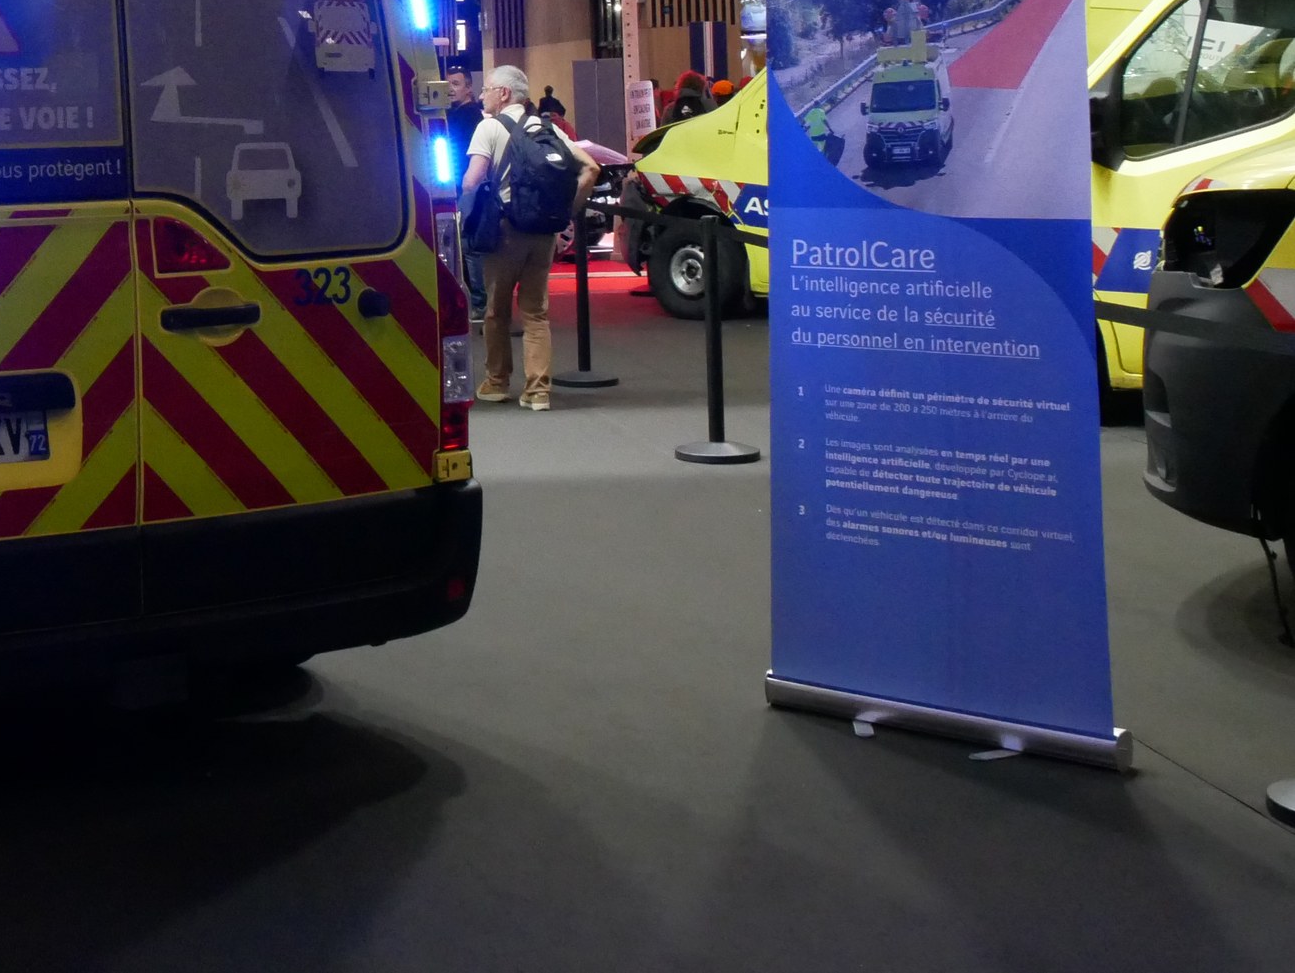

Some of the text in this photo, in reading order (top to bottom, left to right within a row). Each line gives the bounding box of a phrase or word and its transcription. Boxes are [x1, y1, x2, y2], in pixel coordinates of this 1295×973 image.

[19, 106, 79, 131] VOIE
[792, 239, 935, 269] PatrolCare
[293, 266, 351, 306] 323
[791, 274, 993, 299] L'intelligence artificielle
[791, 303, 995, 327] au service de la sécurité
[791, 327, 1040, 357] du personnel en intervention
[797, 386, 804, 397] 1
[842, 386, 876, 397] caméra
[912, 392, 925, 400] un
[977, 395, 990, 406] de
[992, 396, 1034, 408] sécurité
[1035, 400, 1070, 411] virtuel
[880, 401, 891, 411] de
[893, 402, 911, 413] 200
[920, 404, 938, 415] 250
[28, 435, 47, 452] 72
[798, 438, 805, 449] 2
[825, 450, 879, 464] intelligence
[940, 449, 953, 458] en
[955, 450, 987, 463] temps
[988, 453, 1009, 463] réel
[1011, 456, 1028, 466] par
[1030, 458, 1051, 467] une
[825, 478, 900, 494] potentiellement
[872, 469, 913, 481] détecter
[915, 474, 941, 485] toute
[942, 476, 996, 490] trajectoire
[997, 482, 1011, 492] de
[1012, 483, 1057, 497] véhicule
[798, 505, 805, 515] 3
[842, 520, 880, 532] alarmes
[882, 526, 920, 537] sonores
[921, 530, 947, 541] et/ou
[949, 532, 1008, 548] lumineuses
